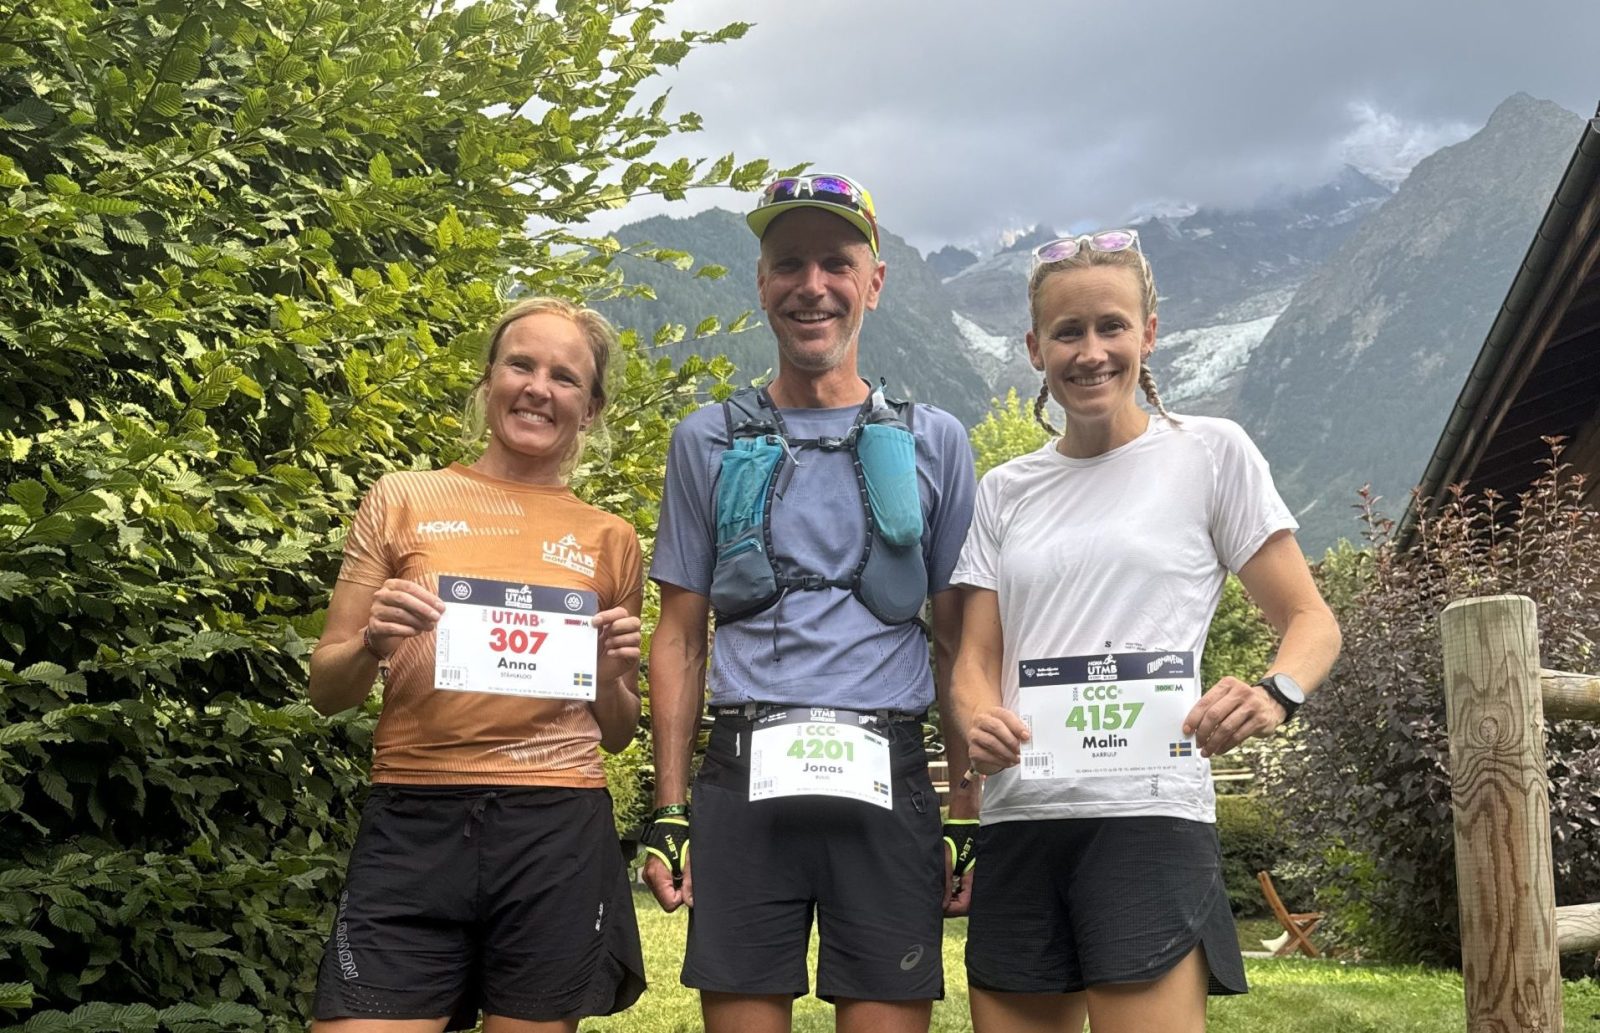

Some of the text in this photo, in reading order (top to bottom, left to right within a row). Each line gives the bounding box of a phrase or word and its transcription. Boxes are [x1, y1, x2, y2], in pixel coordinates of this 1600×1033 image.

[417, 520, 471, 534] HOKA
[543, 541, 596, 567] UTMB
[505, 593, 533, 604] UTMB
[489, 627, 549, 655] 307
[497, 657, 537, 671] Anna
[1087, 665, 1118, 675] UTMB
[810, 708, 836, 717] UTMB
[1065, 702, 1145, 732] 4157
[1082, 734, 1128, 749] Malin
[786, 738, 854, 762] 4201
[802, 762, 844, 774] Jonas
[664, 834, 679, 860] LEKI
[959, 837, 974, 862] LEKI
